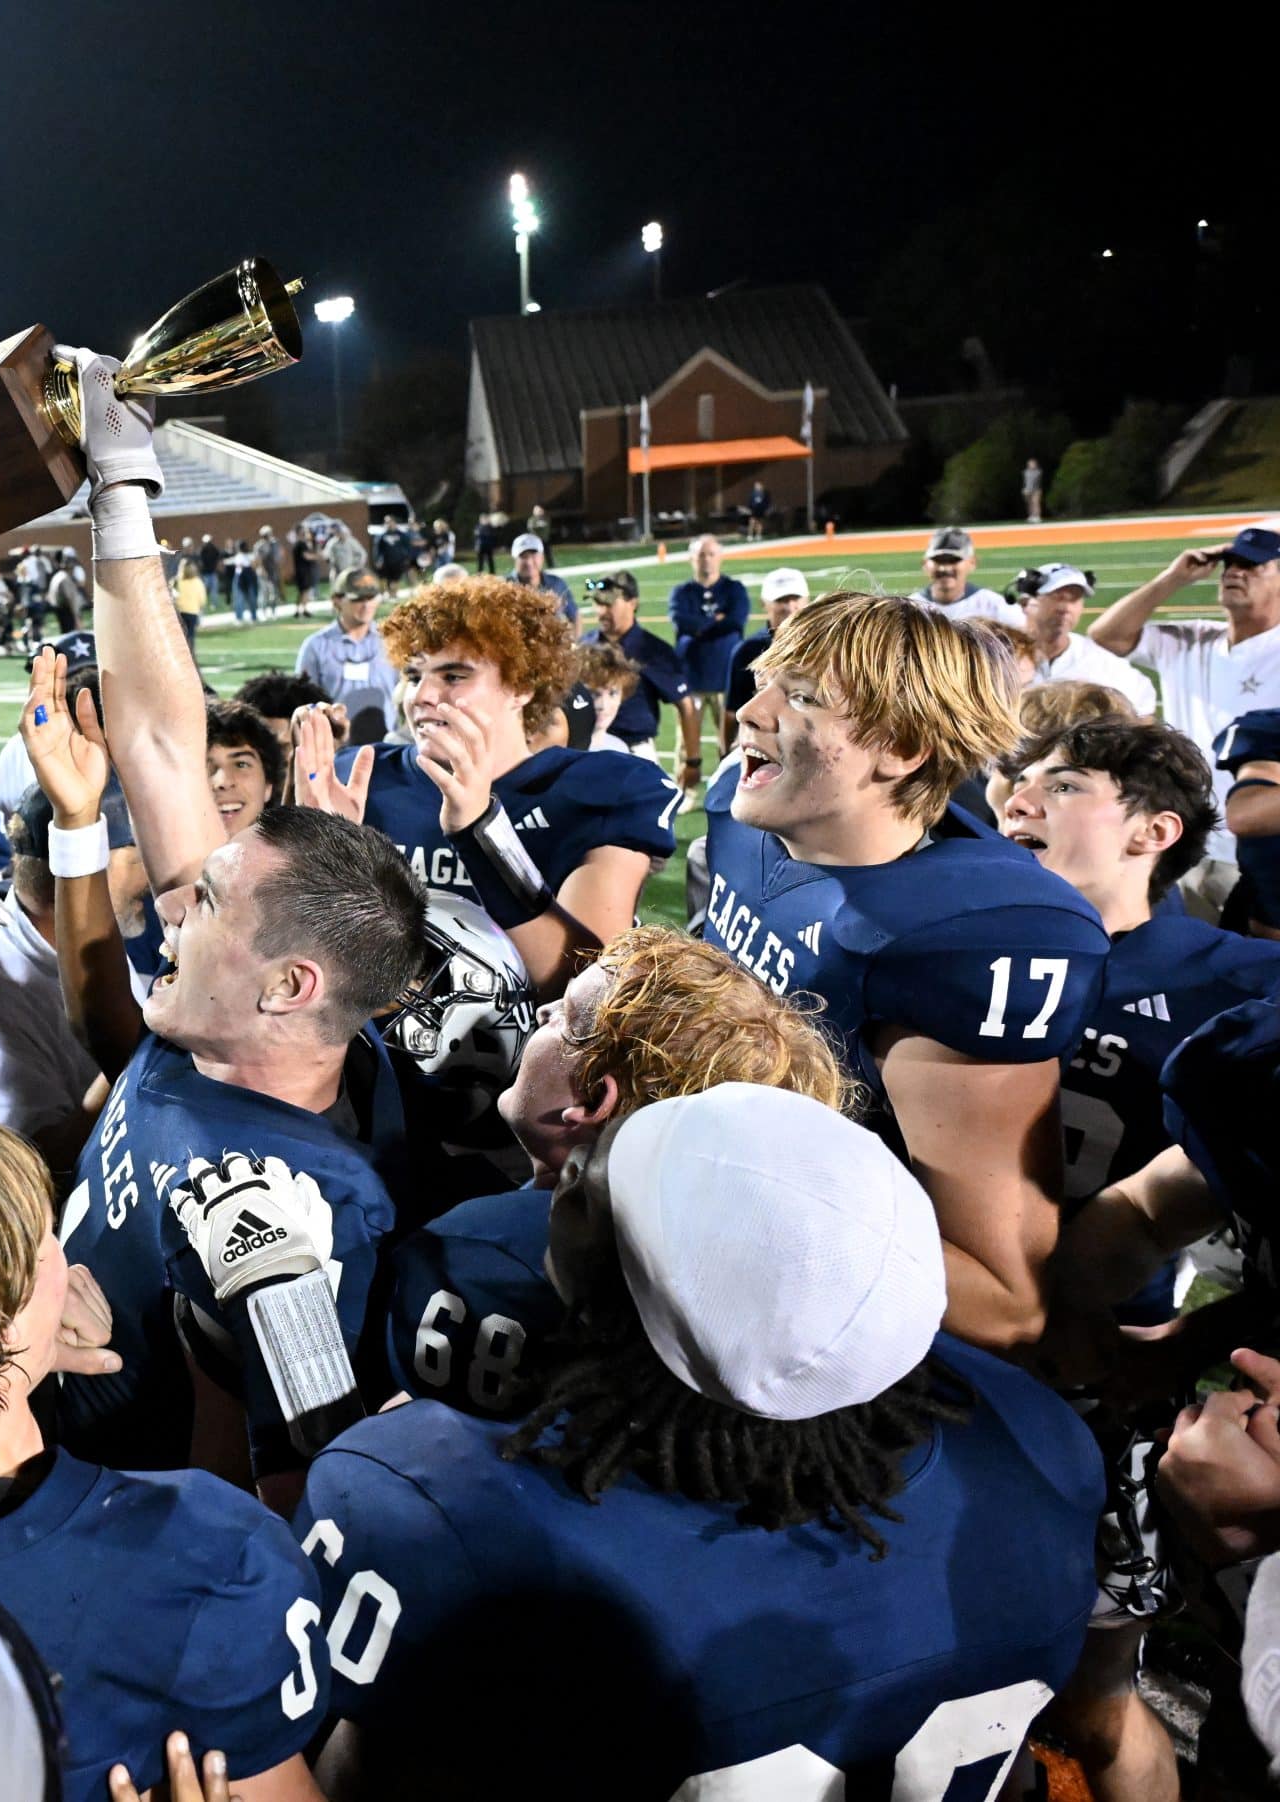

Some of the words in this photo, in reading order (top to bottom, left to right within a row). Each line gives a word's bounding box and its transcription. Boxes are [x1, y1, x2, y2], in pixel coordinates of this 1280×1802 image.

[396, 844, 472, 886] AGL
[708, 873, 795, 996] EAGLES
[978, 956, 1069, 1039] 17
[100, 1071, 139, 1230] AGLES
[223, 1227, 288, 1264] adidas
[414, 1289, 527, 1412] 68
